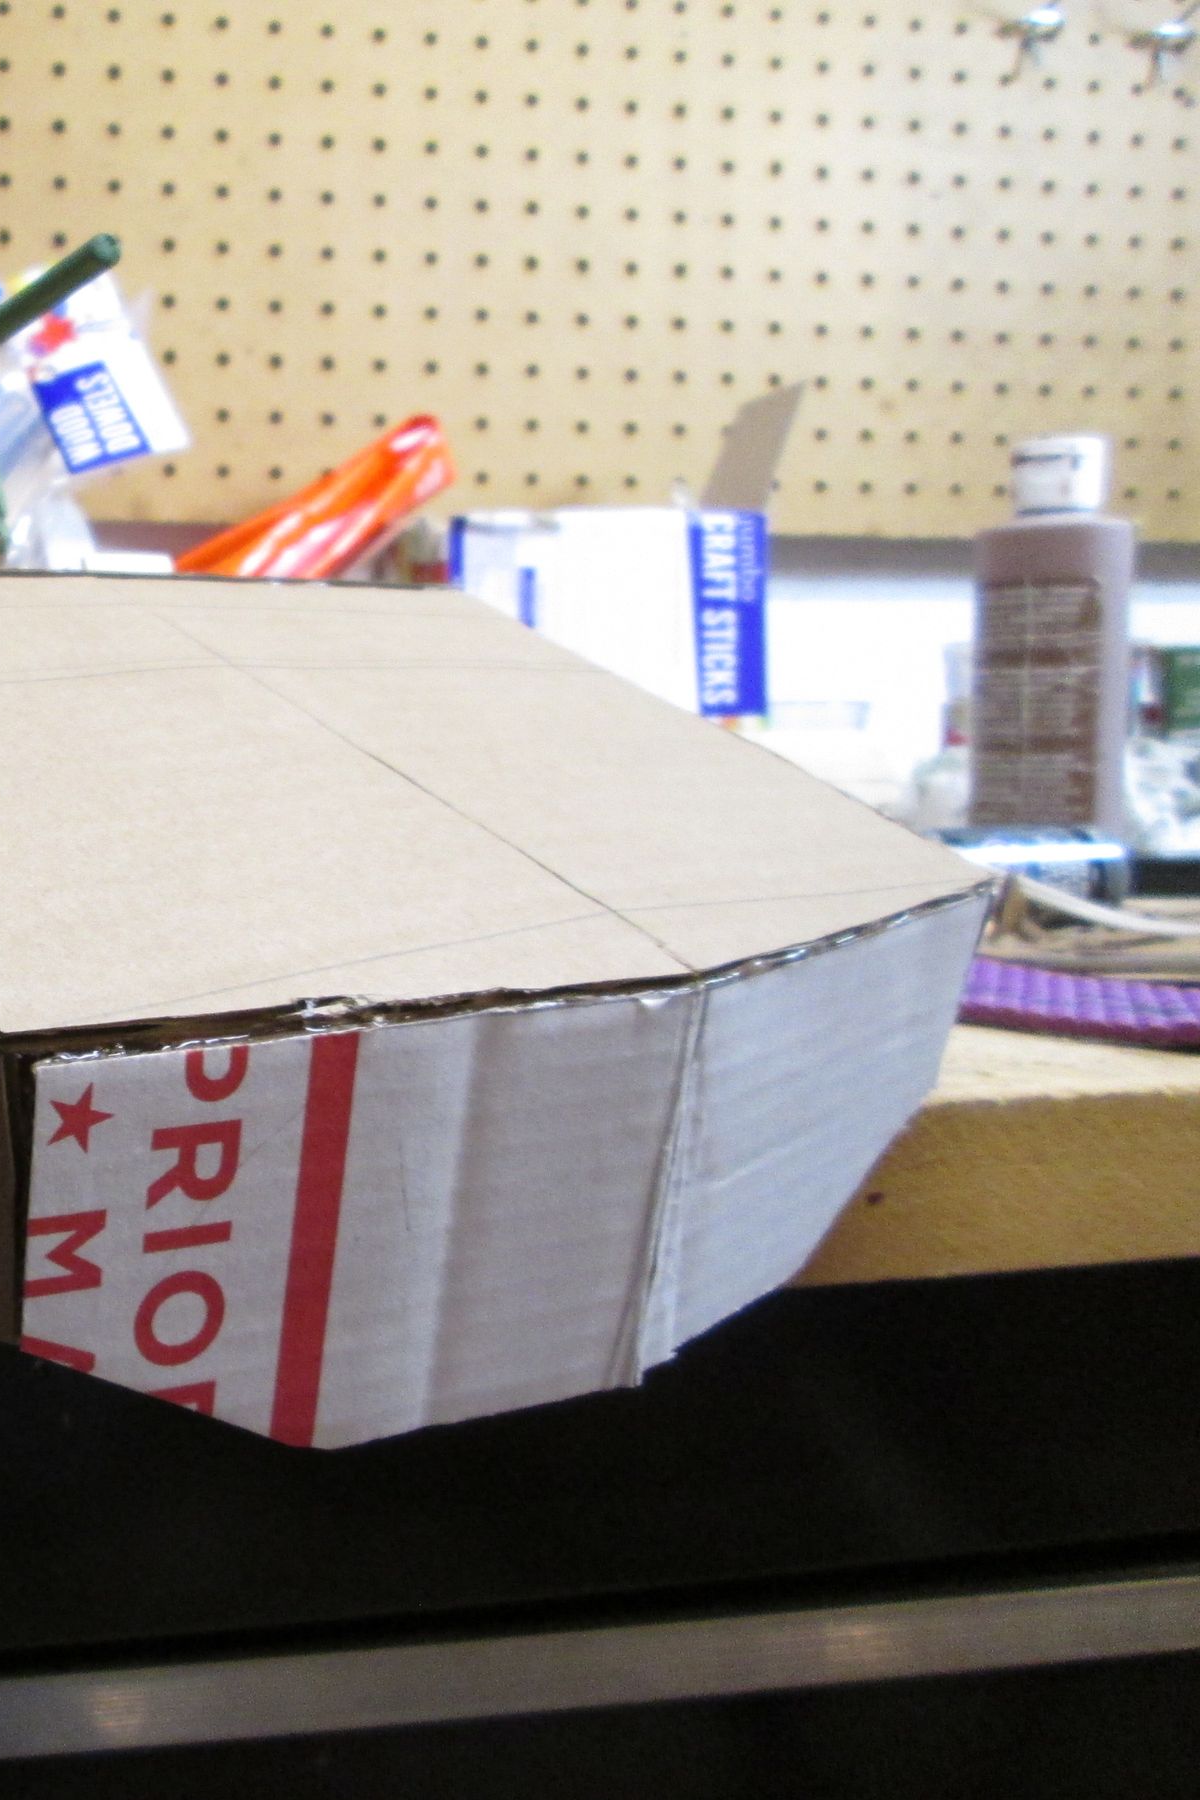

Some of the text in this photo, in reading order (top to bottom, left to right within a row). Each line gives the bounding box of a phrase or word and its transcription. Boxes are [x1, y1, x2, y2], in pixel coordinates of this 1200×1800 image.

[51, 405, 102, 466] WOOD
[75, 371, 142, 454] DOWELS
[700, 513, 739, 705] CRAFT STICKS
